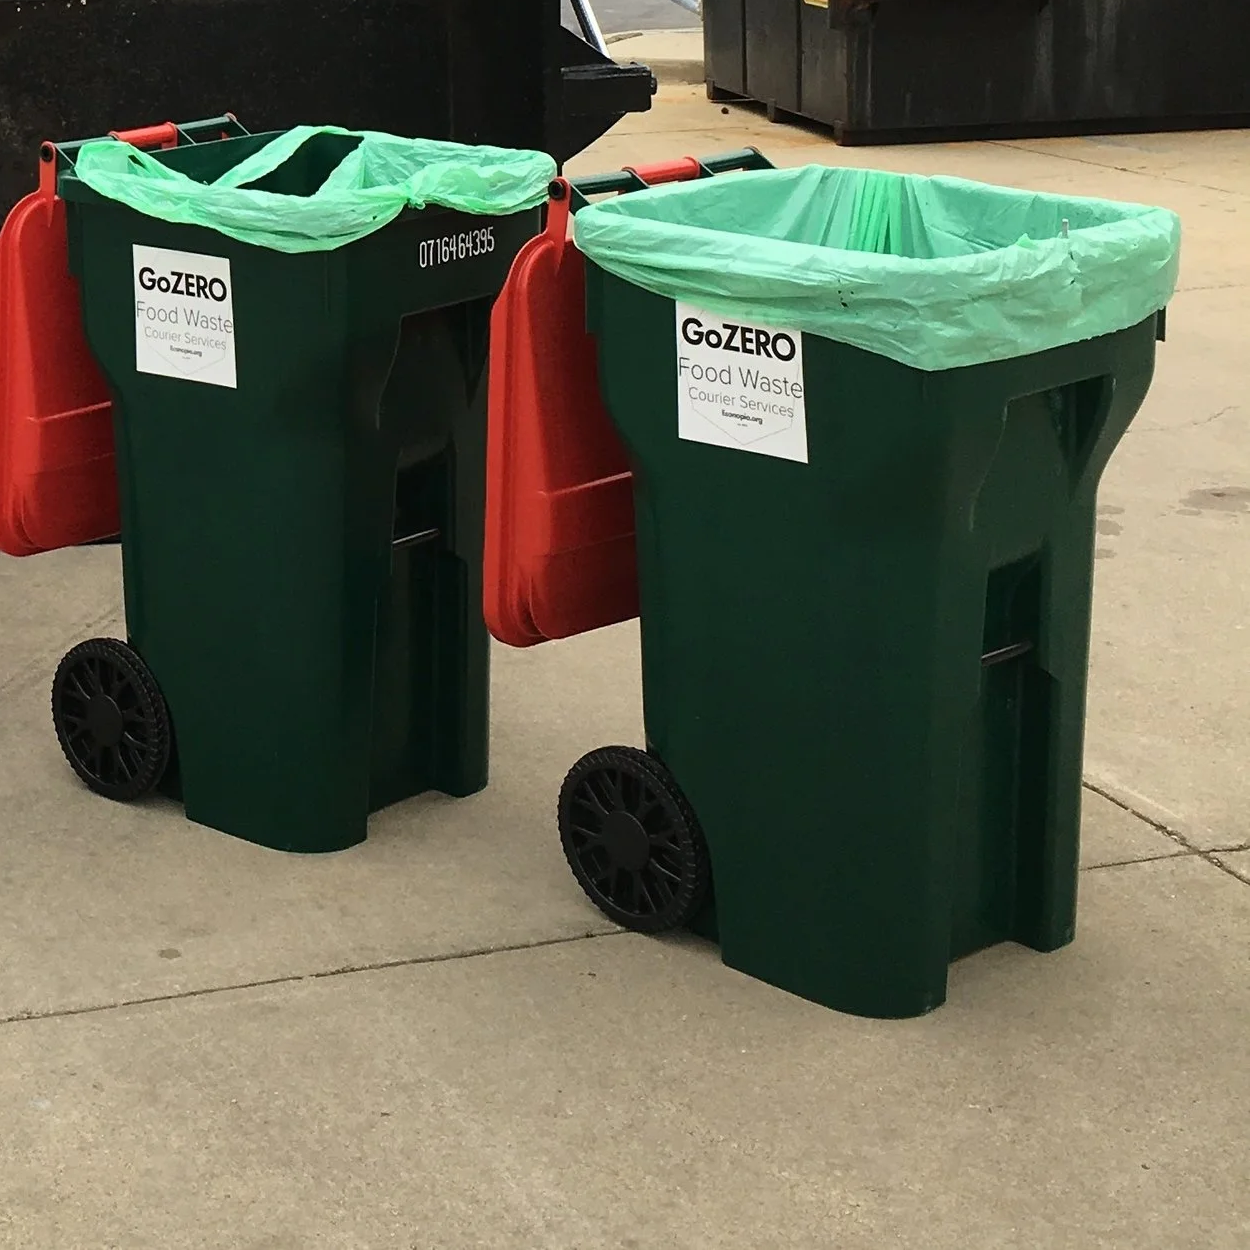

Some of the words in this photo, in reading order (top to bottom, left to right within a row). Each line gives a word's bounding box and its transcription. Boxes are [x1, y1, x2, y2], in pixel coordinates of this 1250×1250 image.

[419, 226, 495, 268] 0716464395
[138, 267, 227, 302] GoZERO
[136, 300, 178, 324] Food
[183, 308, 233, 334] Waste
[144, 326, 181, 342] Courier
[184, 332, 227, 350] Services
[681, 317, 796, 362] GoZERO
[678, 356, 732, 385] Food
[738, 366, 803, 399] Waste
[689, 386, 736, 406] Courier
[740, 395, 794, 418] Services
